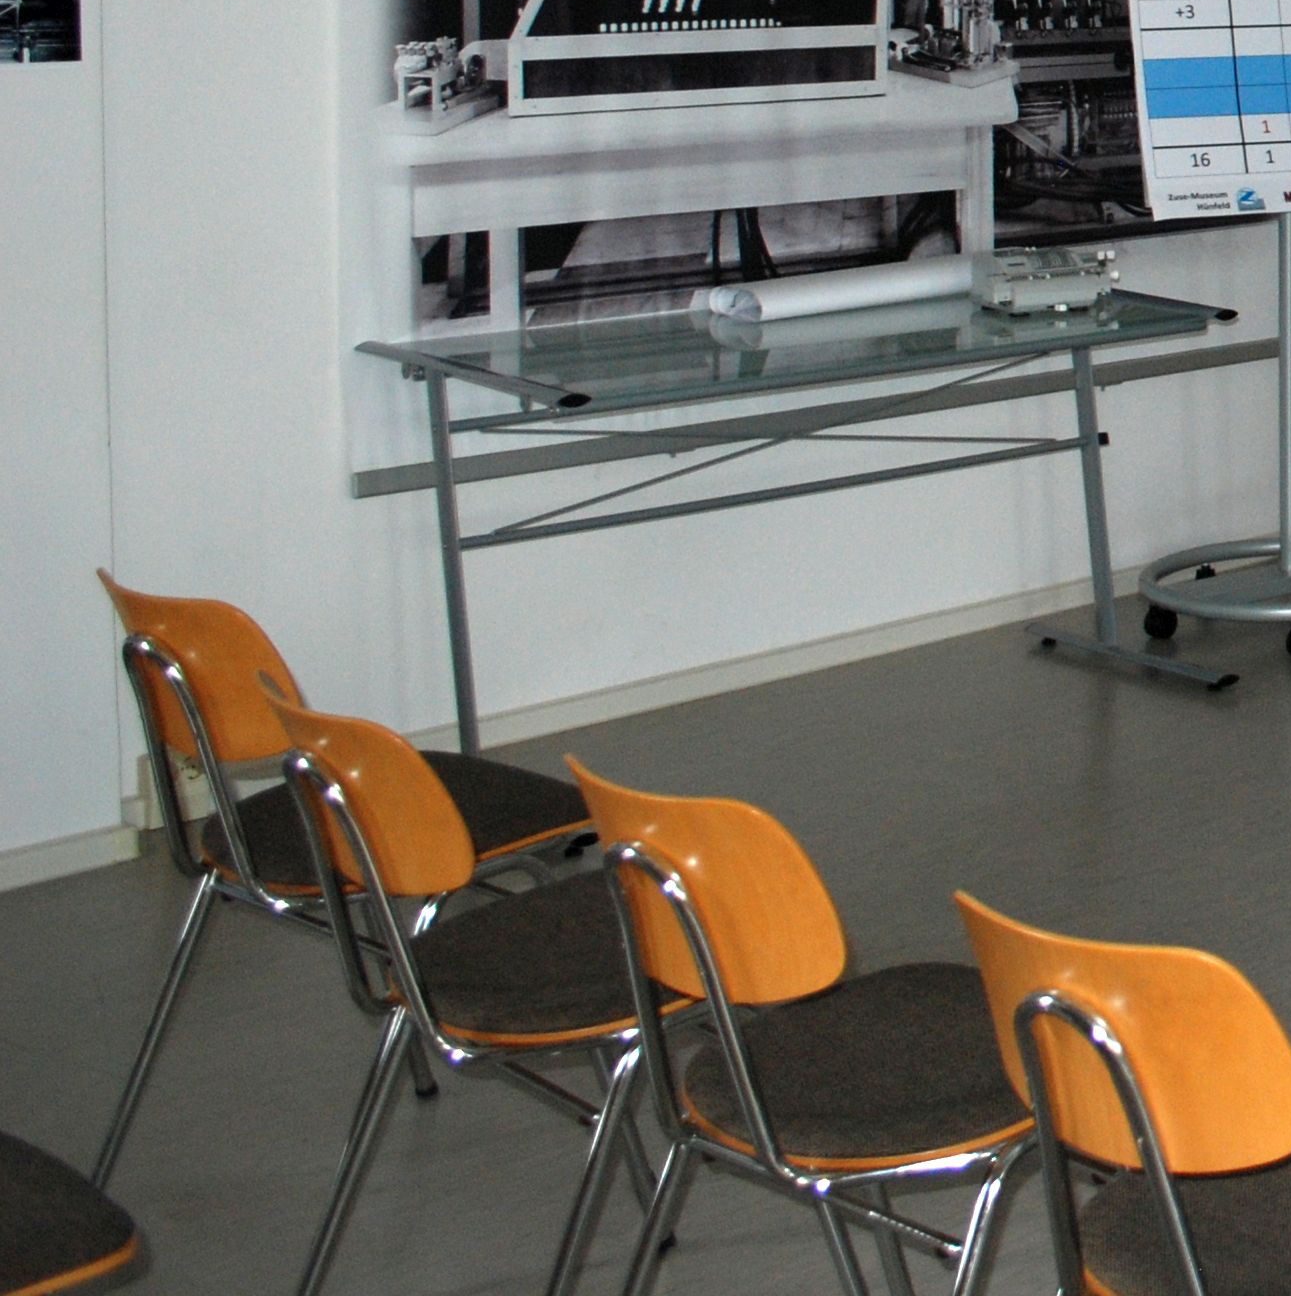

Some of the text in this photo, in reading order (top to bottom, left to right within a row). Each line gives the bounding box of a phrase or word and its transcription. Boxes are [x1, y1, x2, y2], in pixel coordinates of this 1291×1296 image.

[1175, 5, 1195, 20] +3
[1262, 120, 1271, 133] 1
[1191, 153, 1211, 168] 16
[1266, 150, 1274, 164] 1
[1168, 192, 1228, 201] Zuse-Museum
